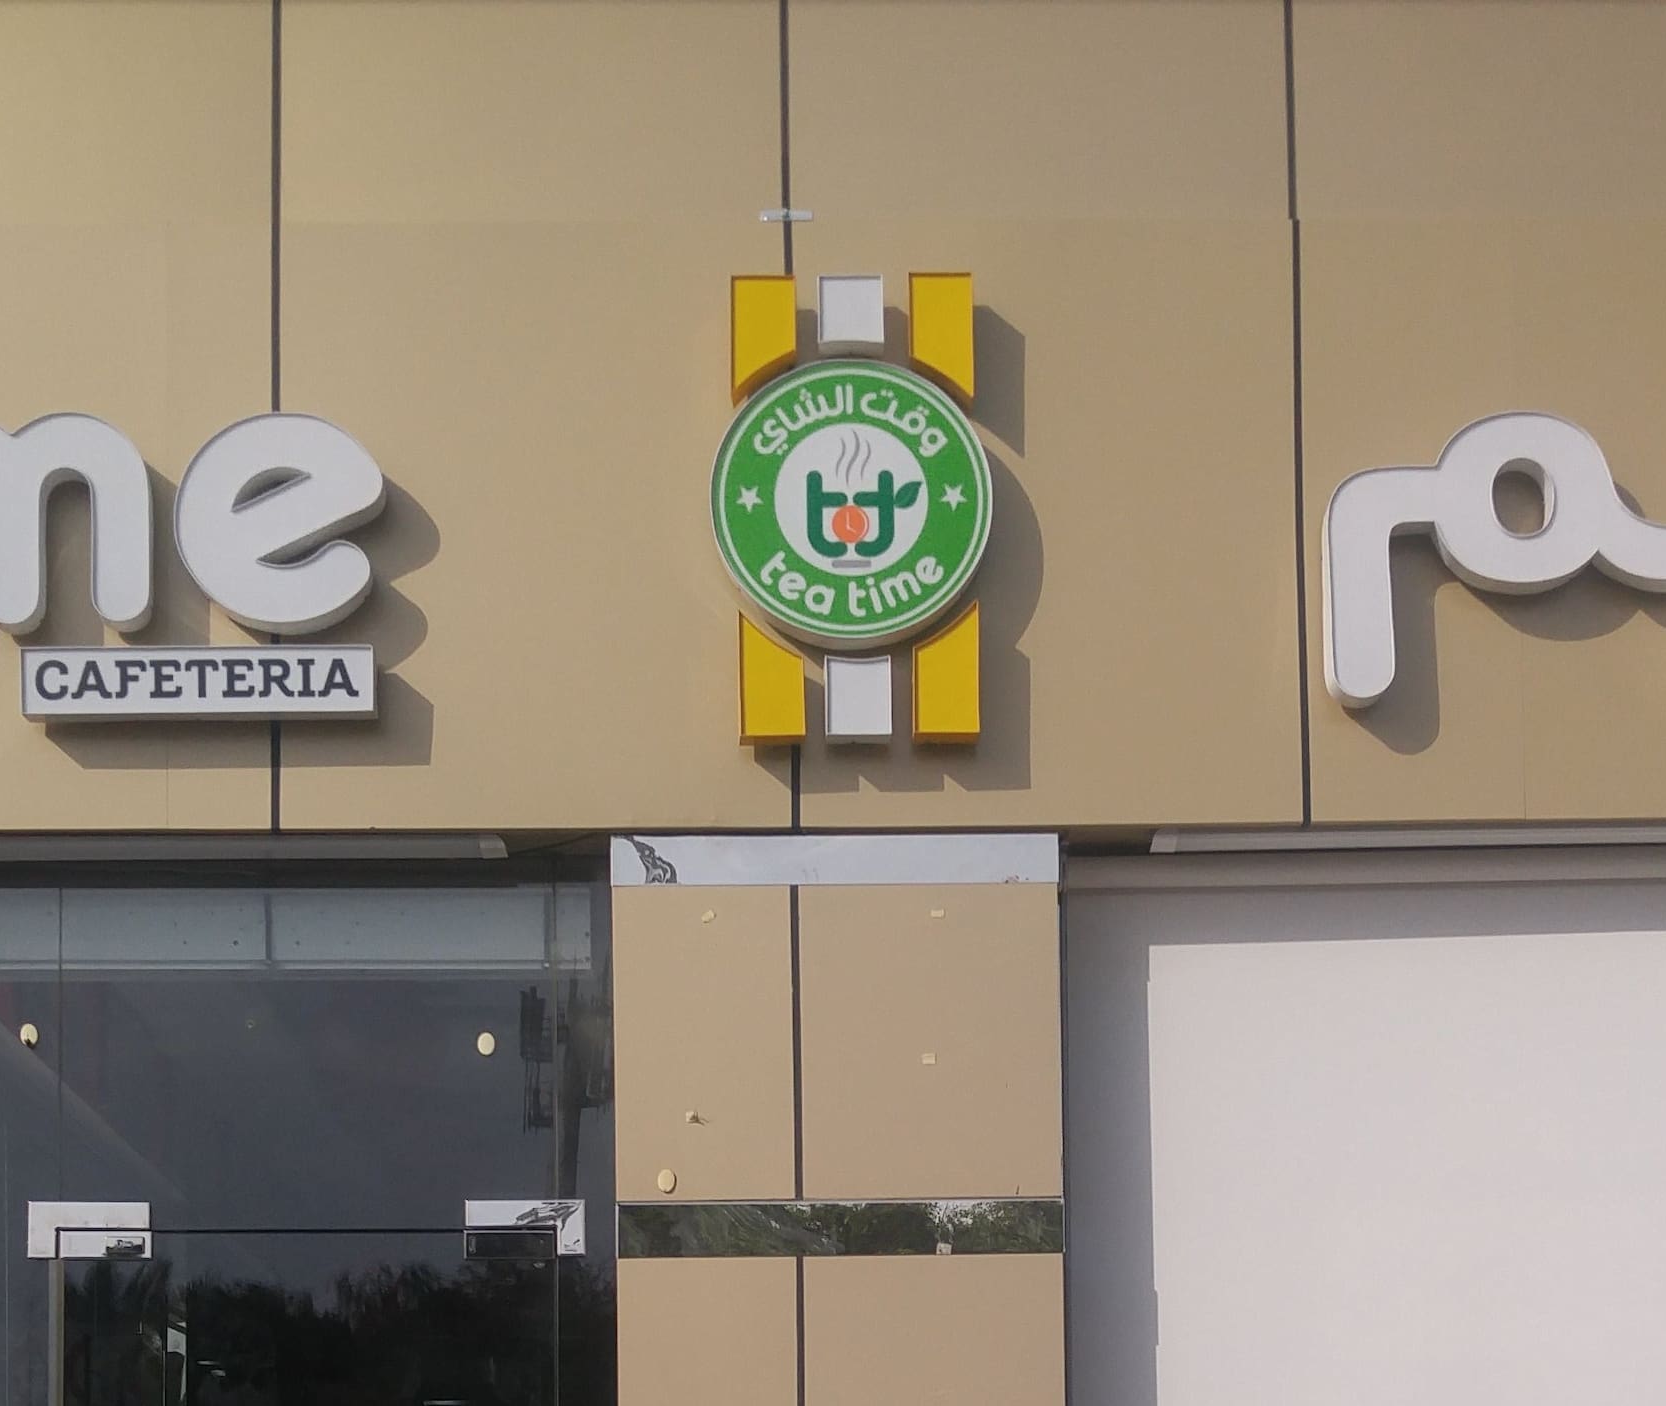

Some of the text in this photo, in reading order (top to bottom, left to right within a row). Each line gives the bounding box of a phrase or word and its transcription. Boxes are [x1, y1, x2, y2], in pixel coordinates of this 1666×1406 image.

[752, 382, 949, 457] وقت الشاي
[760, 551, 945, 617] tea time
[34, 658, 359, 701] CAFETERIA
